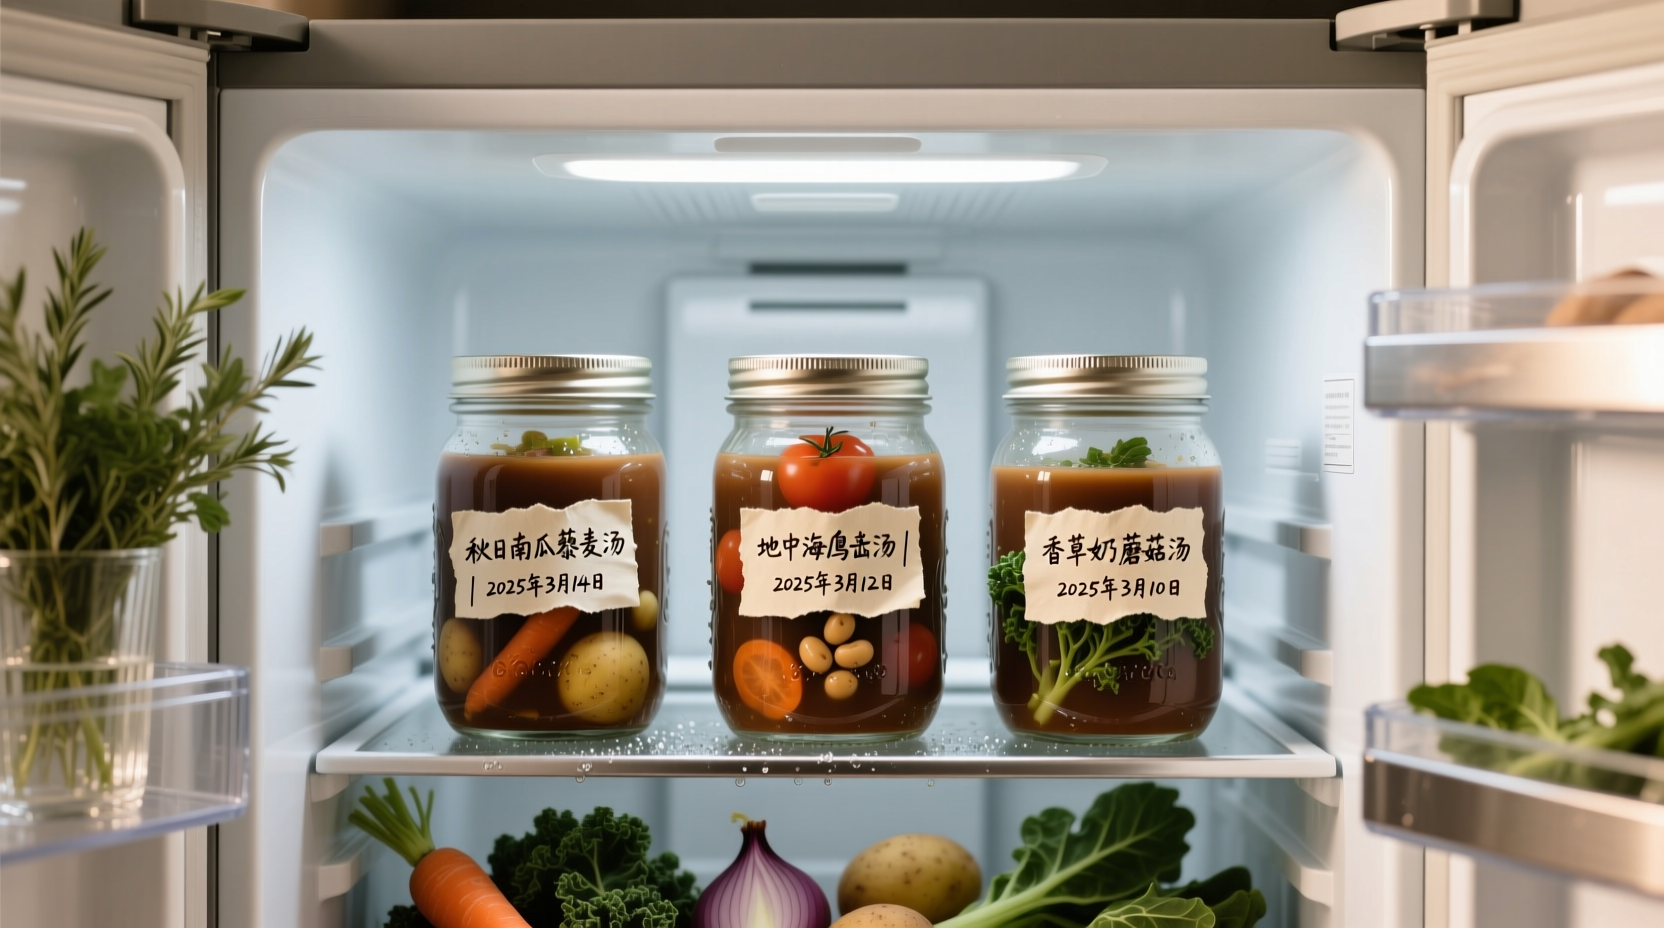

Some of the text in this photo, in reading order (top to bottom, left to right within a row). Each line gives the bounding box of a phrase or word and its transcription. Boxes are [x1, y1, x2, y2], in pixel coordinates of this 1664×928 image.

[464, 527, 625, 564] 秋日南瓜藜麦汤
[1042, 531, 1191, 567] 香草奶蘑菇汤
[486, 572, 603, 598] 2025年3月14日
[772, 570, 893, 597] 2025年3月12日
[1056, 575, 1180, 602] 2025年3月10日
